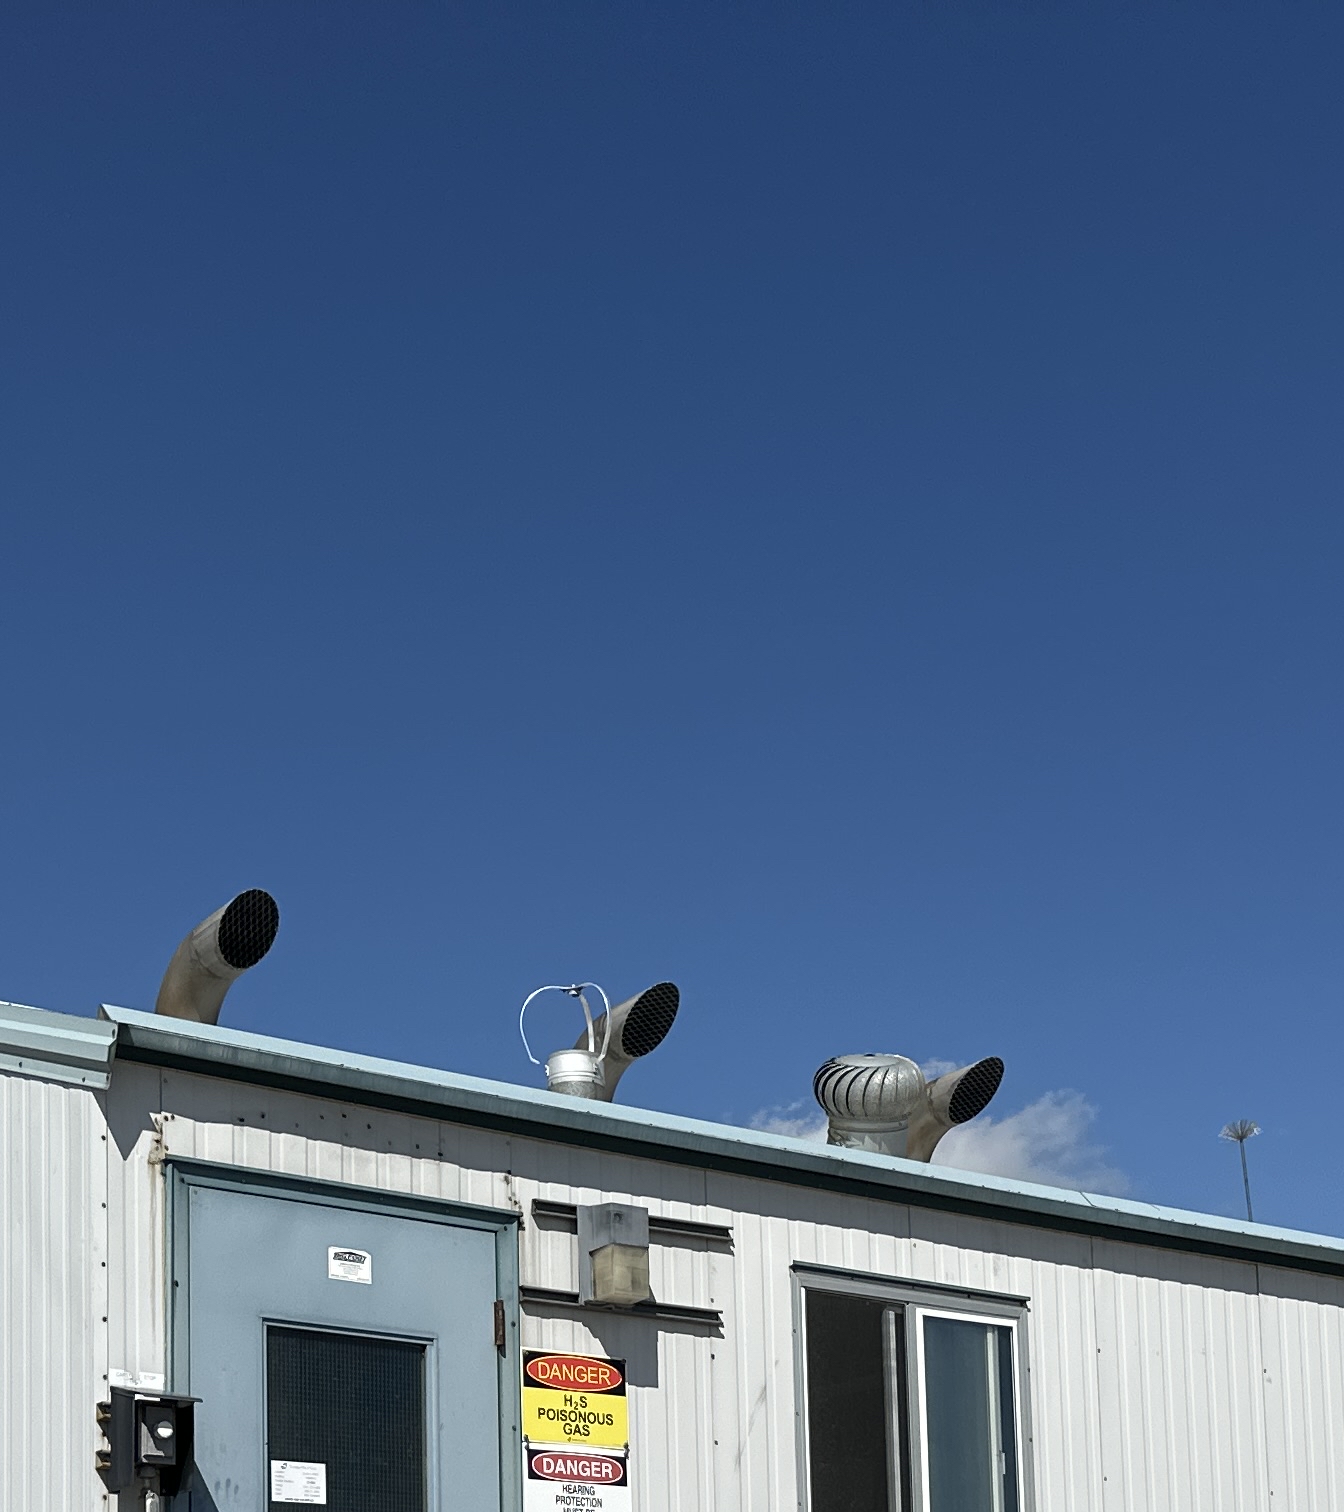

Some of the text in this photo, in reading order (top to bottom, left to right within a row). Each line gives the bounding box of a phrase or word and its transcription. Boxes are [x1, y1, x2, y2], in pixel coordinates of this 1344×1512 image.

[537, 1361, 612, 1386] DANGER
[537, 1407, 614, 1426] POISONOUS
[563, 1423, 591, 1437] GAS
[542, 1457, 613, 1478] DANGER
[562, 1484, 596, 1496] HEARING
[555, 1495, 603, 1508] PROTECTION
